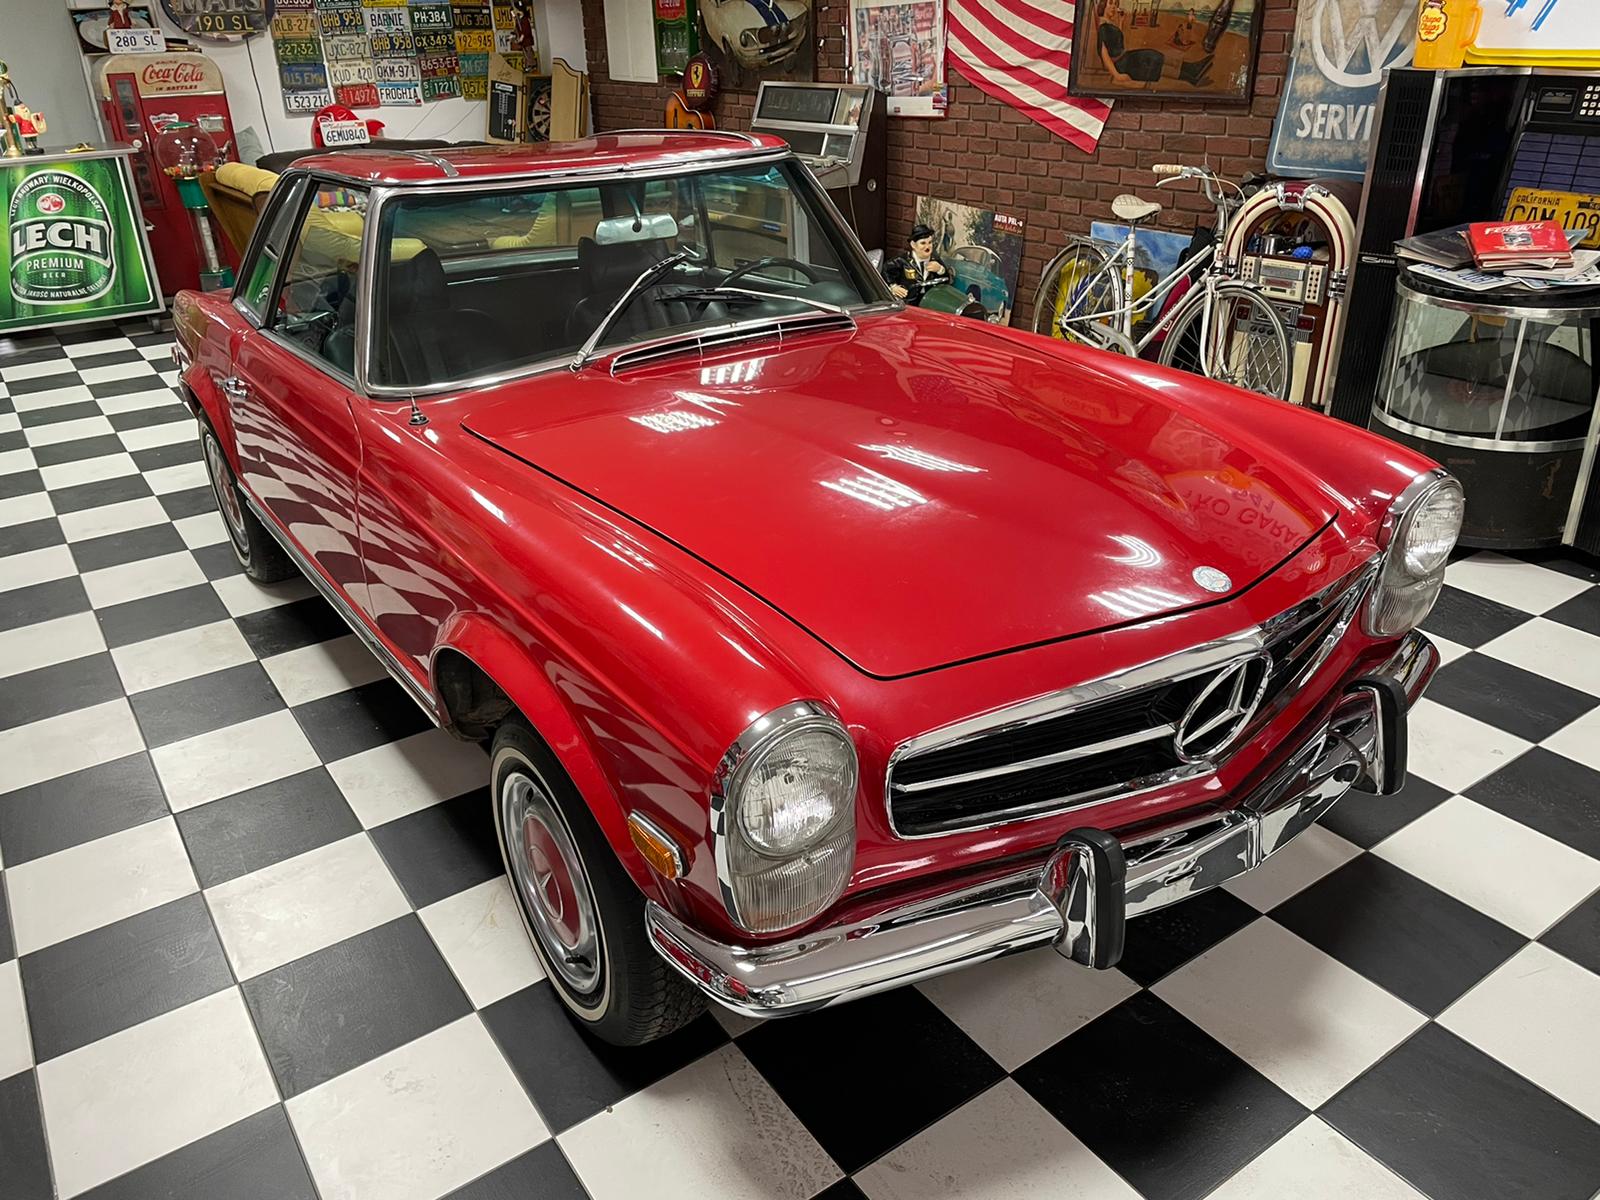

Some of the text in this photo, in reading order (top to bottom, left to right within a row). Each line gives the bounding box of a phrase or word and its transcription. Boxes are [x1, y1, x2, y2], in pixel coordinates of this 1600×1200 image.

[195, 15, 254, 31] 190 SL
[343, 12, 363, 26] 958
[370, 13, 405, 27] BARNIE
[115, 35, 158, 47] 280 SL
[393, 35, 413, 49] 958
[143, 62, 205, 85] Coca-Cola
[294, 96, 311, 108] 523
[1296, 102, 1376, 140] SERVI
[326, 127, 367, 142] 6EMU840
[1516, 194, 1560, 206] CALIFORNIA
[13, 222, 102, 256] LECH
[26, 257, 84, 271] PREMIUM
